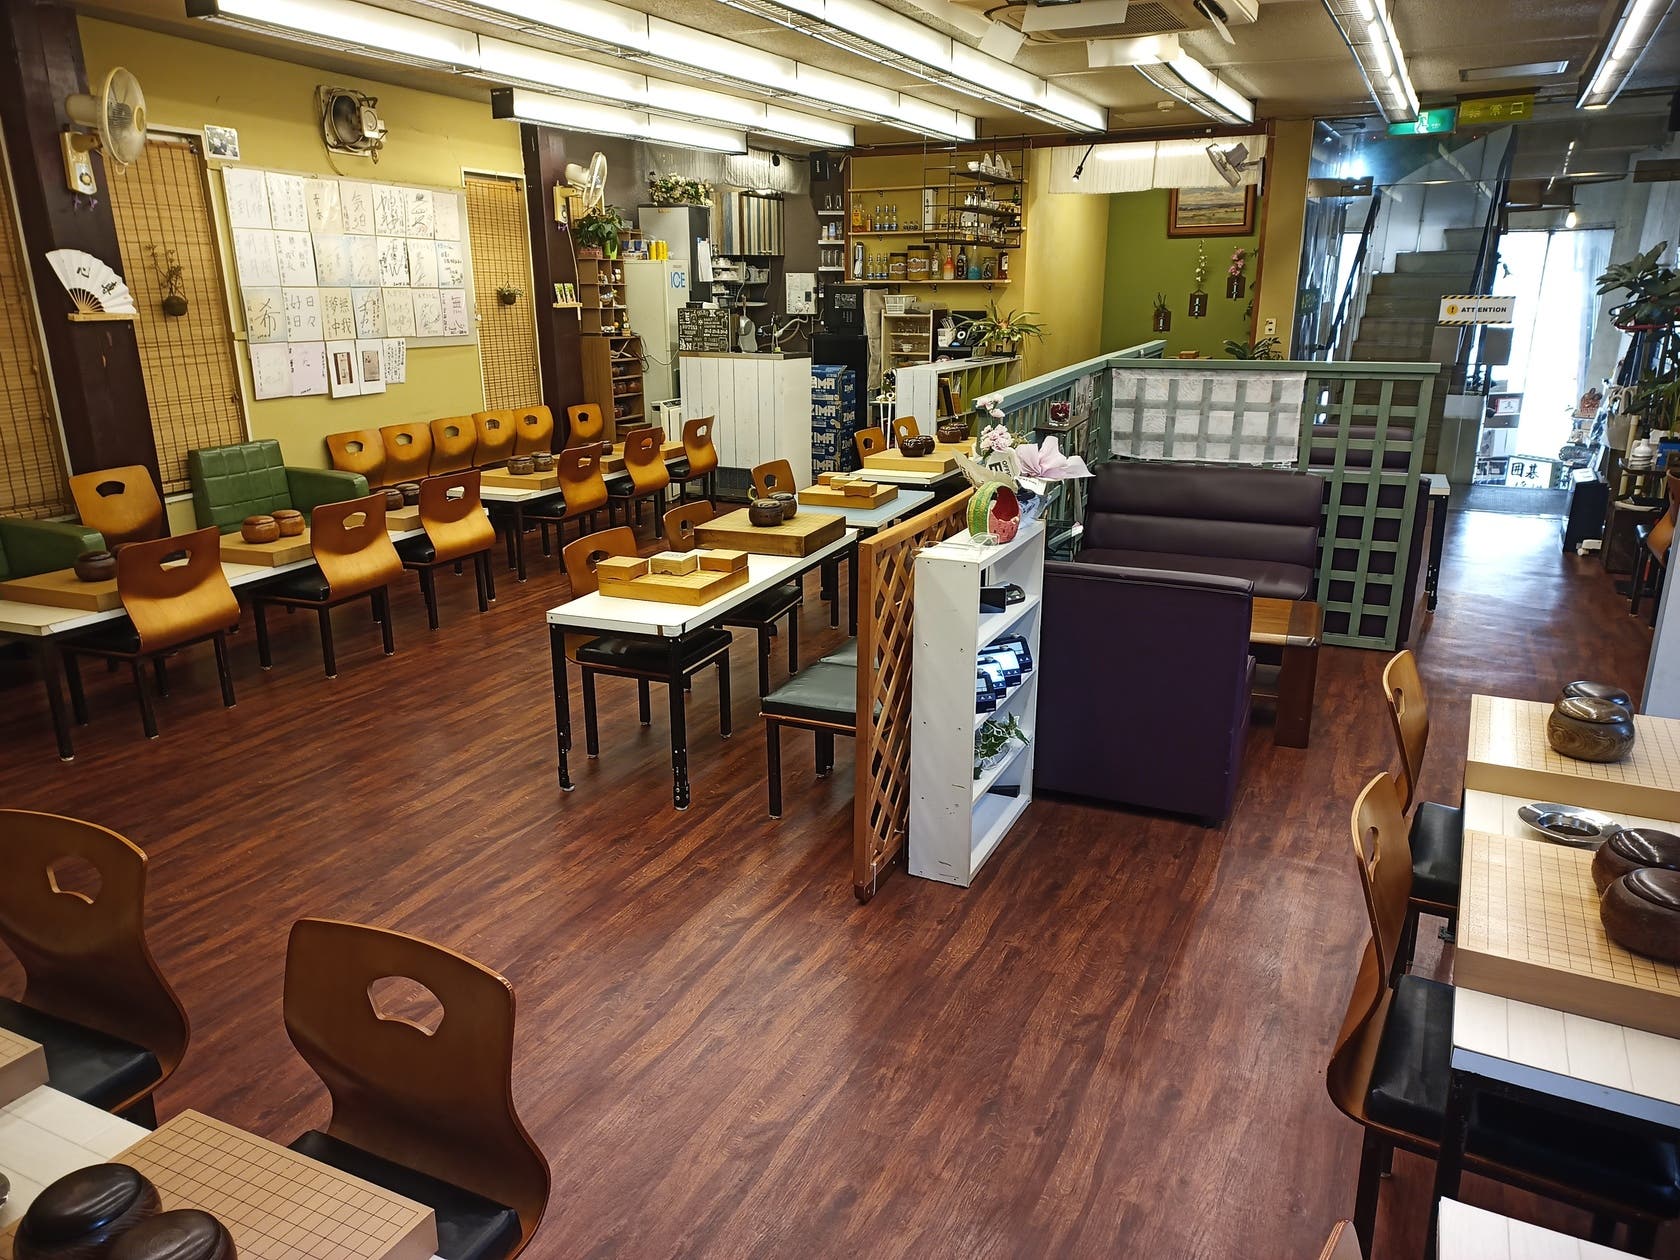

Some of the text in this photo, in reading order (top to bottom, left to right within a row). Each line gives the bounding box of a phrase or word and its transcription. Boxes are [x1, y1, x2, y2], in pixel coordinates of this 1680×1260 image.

[670, 272, 686, 288] ICE
[812, 432, 835, 444] IMA
[1511, 462, 1540, 480] 囲碁
